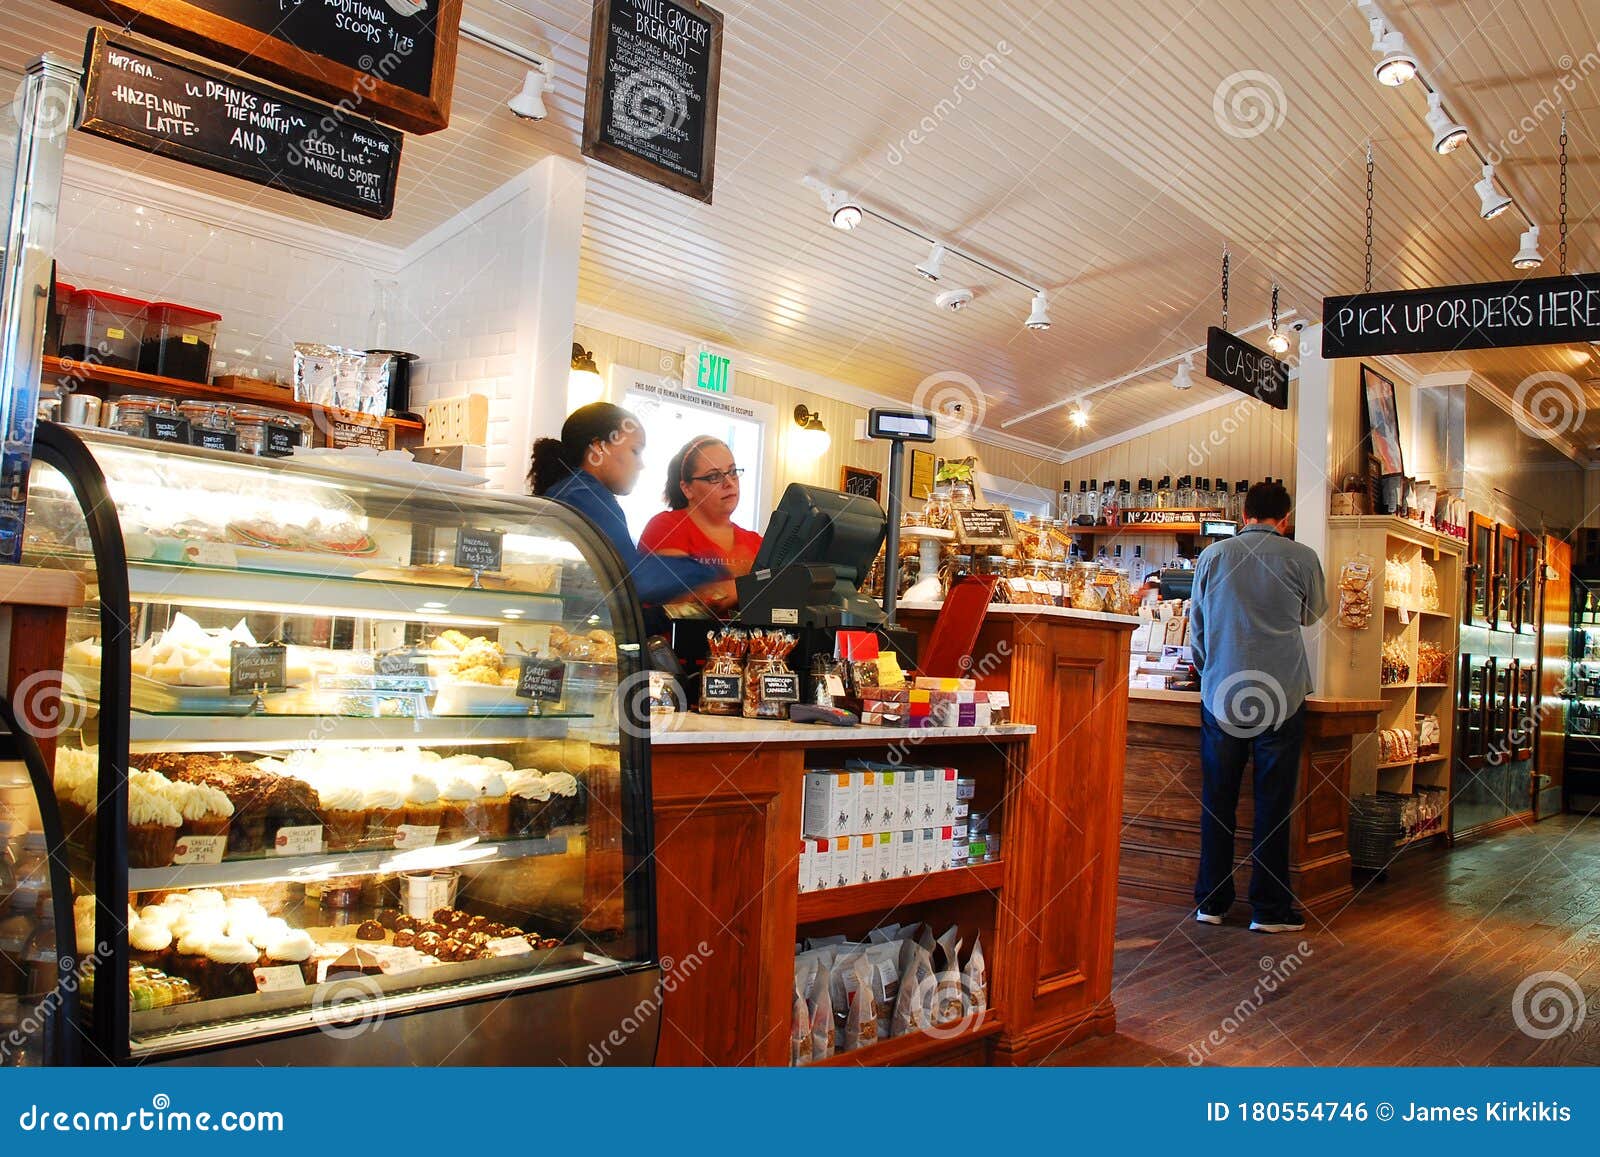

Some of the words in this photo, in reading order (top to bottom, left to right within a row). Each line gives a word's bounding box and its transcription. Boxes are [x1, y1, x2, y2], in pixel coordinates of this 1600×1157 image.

[335, 13, 382, 44] SCOOPS
[636, 12, 689, 59] BREAKFAST
[667, 9, 708, 47] GROCERY
[635, 35, 660, 57] SAUSAGE
[117, 85, 191, 119] HAZELNUT
[206, 81, 258, 110] DRINKS
[263, 102, 281, 117] OF
[146, 111, 195, 136] LATTE
[224, 103, 248, 121] THE
[250, 112, 290, 135] MONTH
[230, 127, 267, 154] AND
[352, 133, 367, 145] ASK
[367, 138, 378, 148] US
[378, 141, 390, 155] FOR
[304, 156, 344, 180] MANGO
[347, 167, 381, 187] SPORT
[1339, 304, 1397, 338] PICK
[1539, 289, 1600, 328] HERE
[697, 351, 731, 394] EXIT
[1142, 511, 1165, 525] 209
